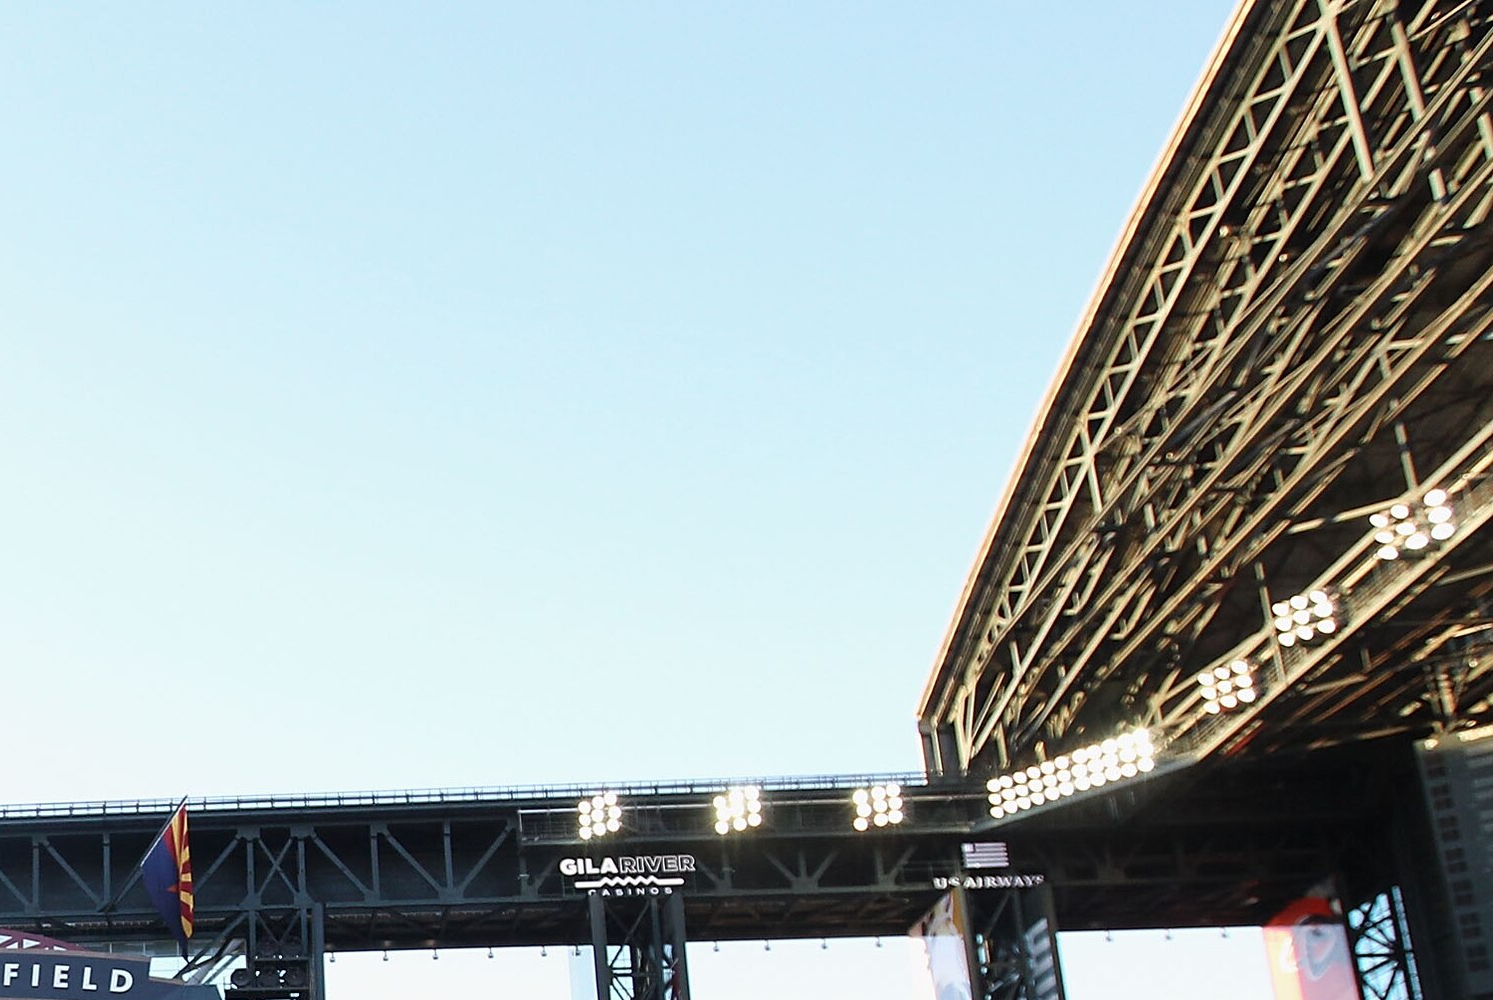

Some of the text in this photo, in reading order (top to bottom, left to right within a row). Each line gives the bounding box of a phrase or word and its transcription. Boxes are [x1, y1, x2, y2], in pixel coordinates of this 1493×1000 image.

[559, 854, 696, 876] GILA RIVER
[588, 886, 673, 897] CASINOS
[933, 874, 1045, 890] US AIRWAYS
[3, 963, 134, 994] FIELD
